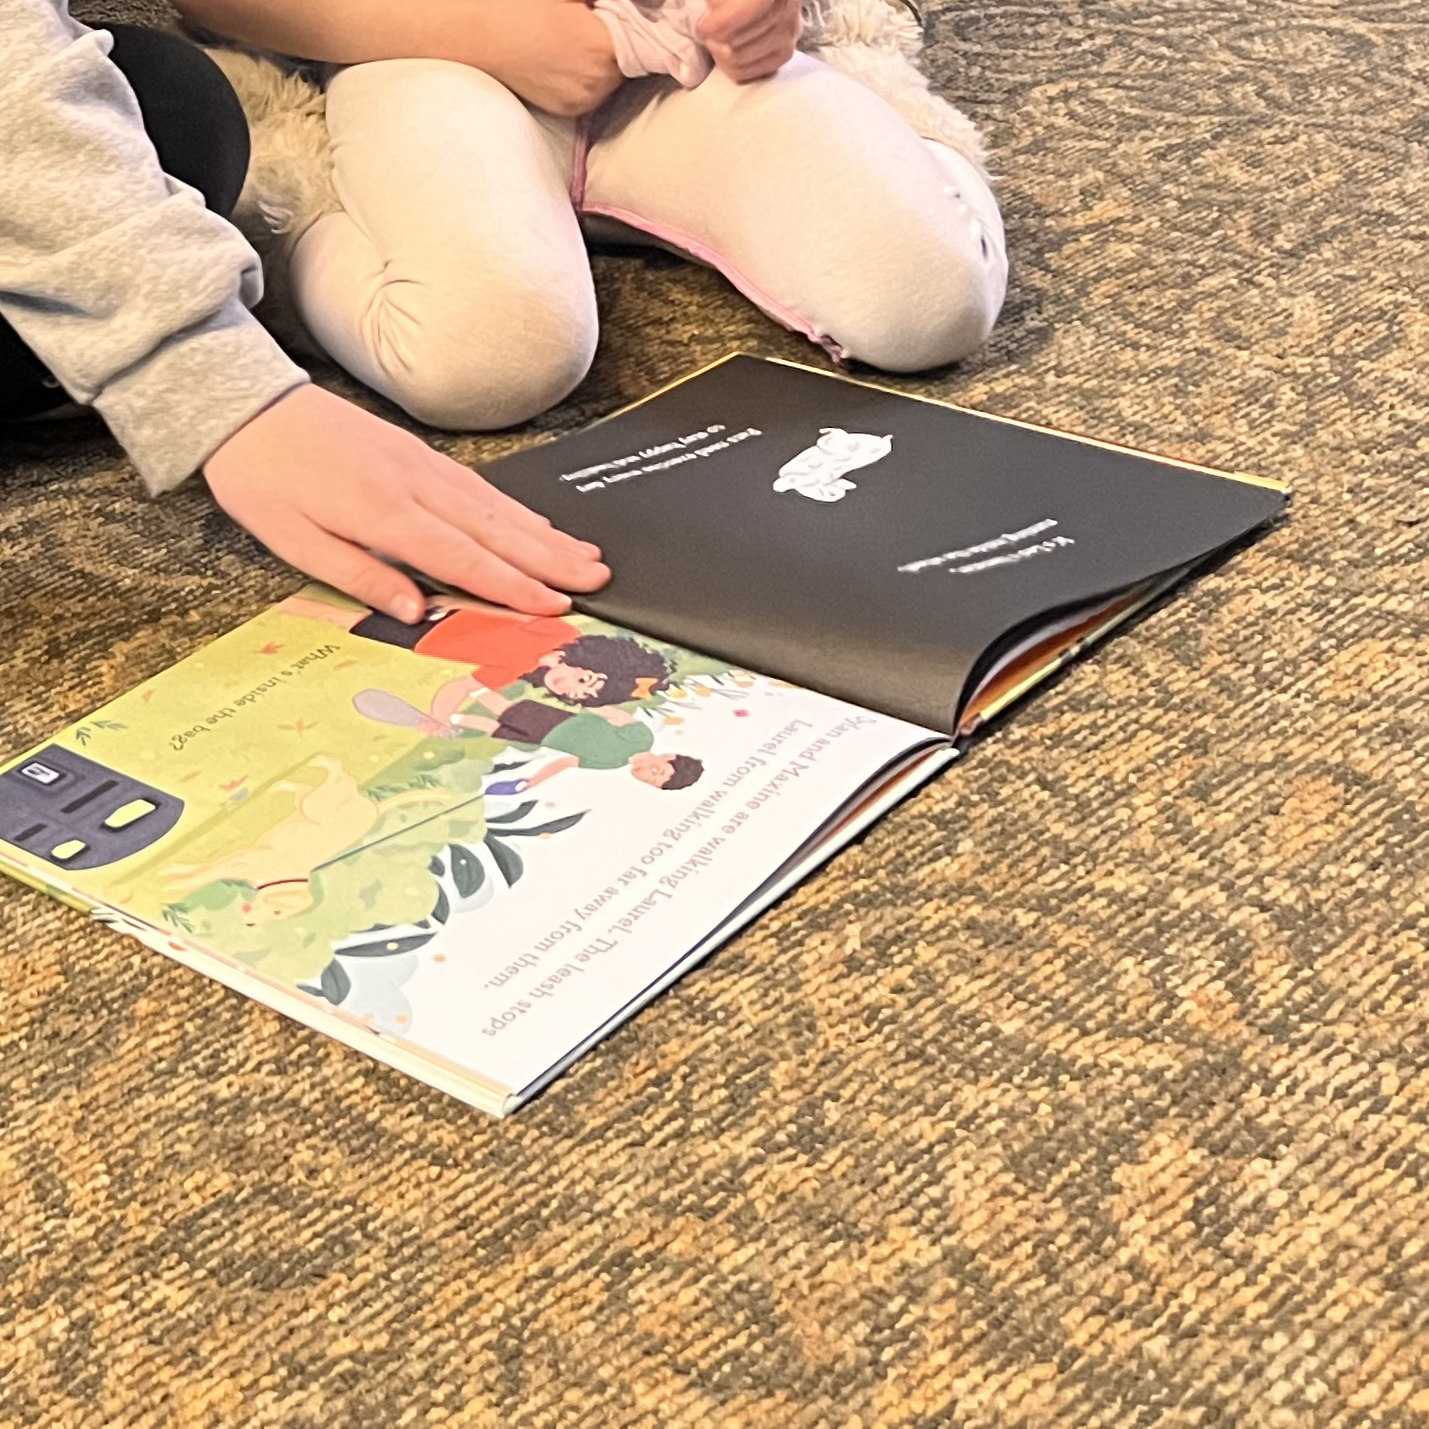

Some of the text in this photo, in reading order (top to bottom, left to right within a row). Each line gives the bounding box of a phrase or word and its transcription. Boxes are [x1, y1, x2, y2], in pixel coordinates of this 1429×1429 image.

[280, 644, 342, 677] What's
[233, 676, 288, 707] inside
[204, 707, 237, 725] the
[797, 737, 831, 762] and
[745, 760, 810, 811] Maxine
[720, 810, 750, 835] are
[483, 718, 815, 990] Laurel from walking too far away from them.
[658, 836, 727, 890] walking
[606, 888, 674, 935] Laurel.
[574, 937, 619, 963] The
[527, 962, 586, 999] leash
[481, 999, 533, 1037] stops
